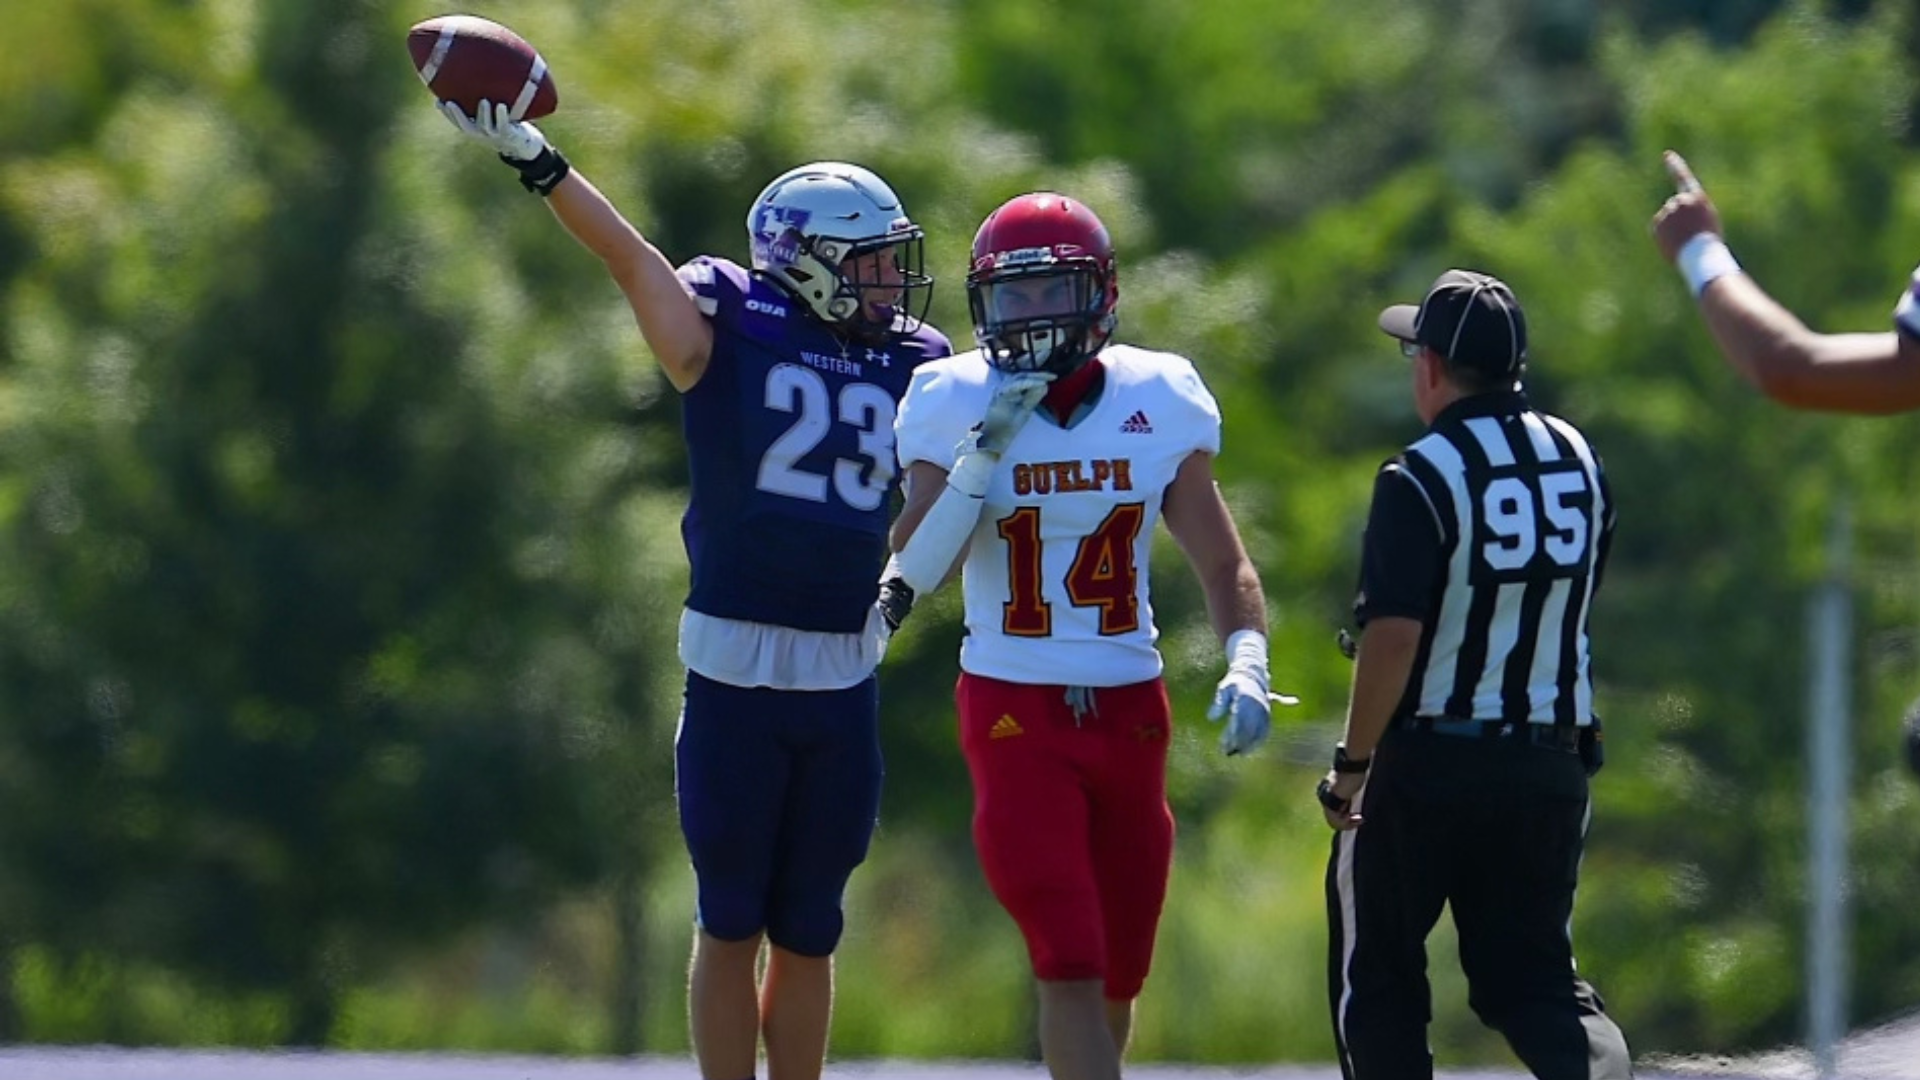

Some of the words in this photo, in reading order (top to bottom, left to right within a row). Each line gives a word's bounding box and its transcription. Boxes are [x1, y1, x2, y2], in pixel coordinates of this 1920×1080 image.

[800, 351, 862, 377] WESTERN
[756, 362, 896, 511] 23
[1013, 460, 1133, 495] GUELPH
[997, 501, 1145, 637] 14
[1483, 470, 1588, 570] 95
